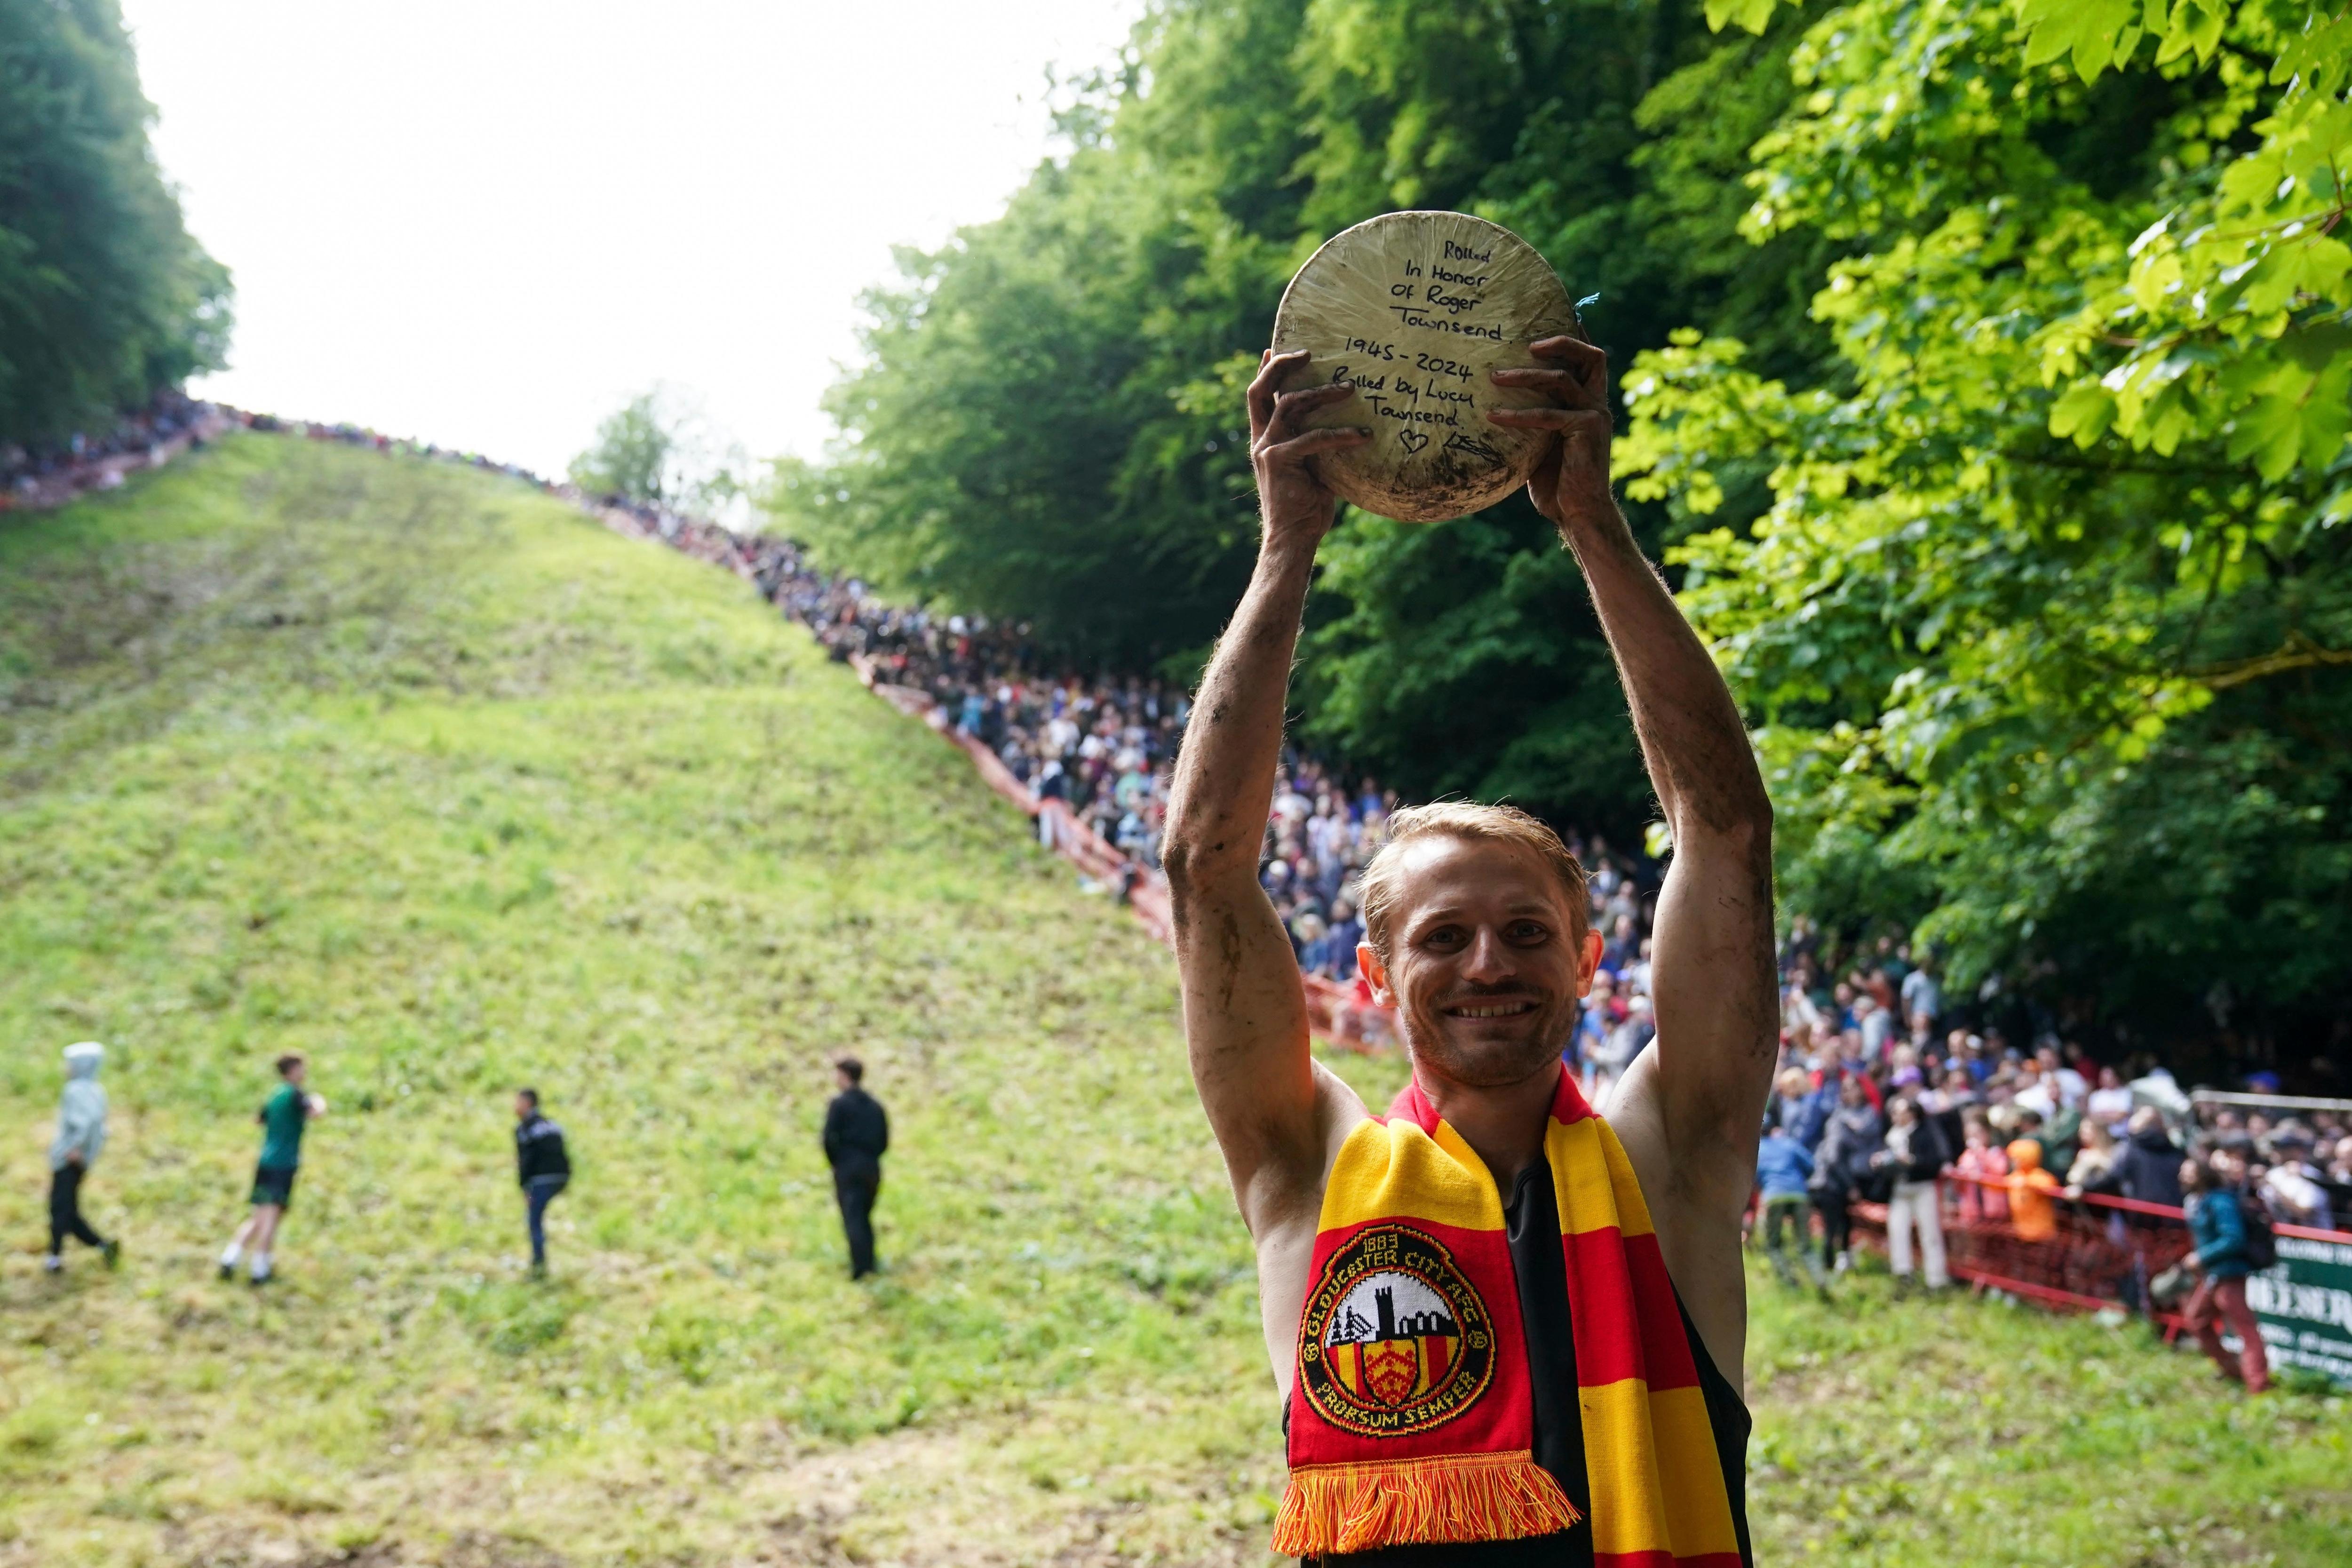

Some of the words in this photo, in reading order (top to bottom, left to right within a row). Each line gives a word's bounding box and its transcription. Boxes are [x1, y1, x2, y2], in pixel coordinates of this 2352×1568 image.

[1444, 240, 1491, 263] Rolled
[1406, 259, 1421, 277] In
[1432, 264, 1487, 287] Honor
[1427, 285, 1482, 315] Roger
[1346, 337, 1394, 361] 1945
[1416, 353, 1473, 383] 2024
[1395, 377, 1418, 403] by
[1426, 379, 1474, 408] Lucy
[1363, 1233, 1398, 1253] 1883
[1307, 1250, 1397, 1337] GLOUCESTER
[1405, 1251, 1450, 1281] CITY
[1317, 1382, 1398, 1427] PRORSUM
[1405, 1371, 1477, 1424] SEMPER
